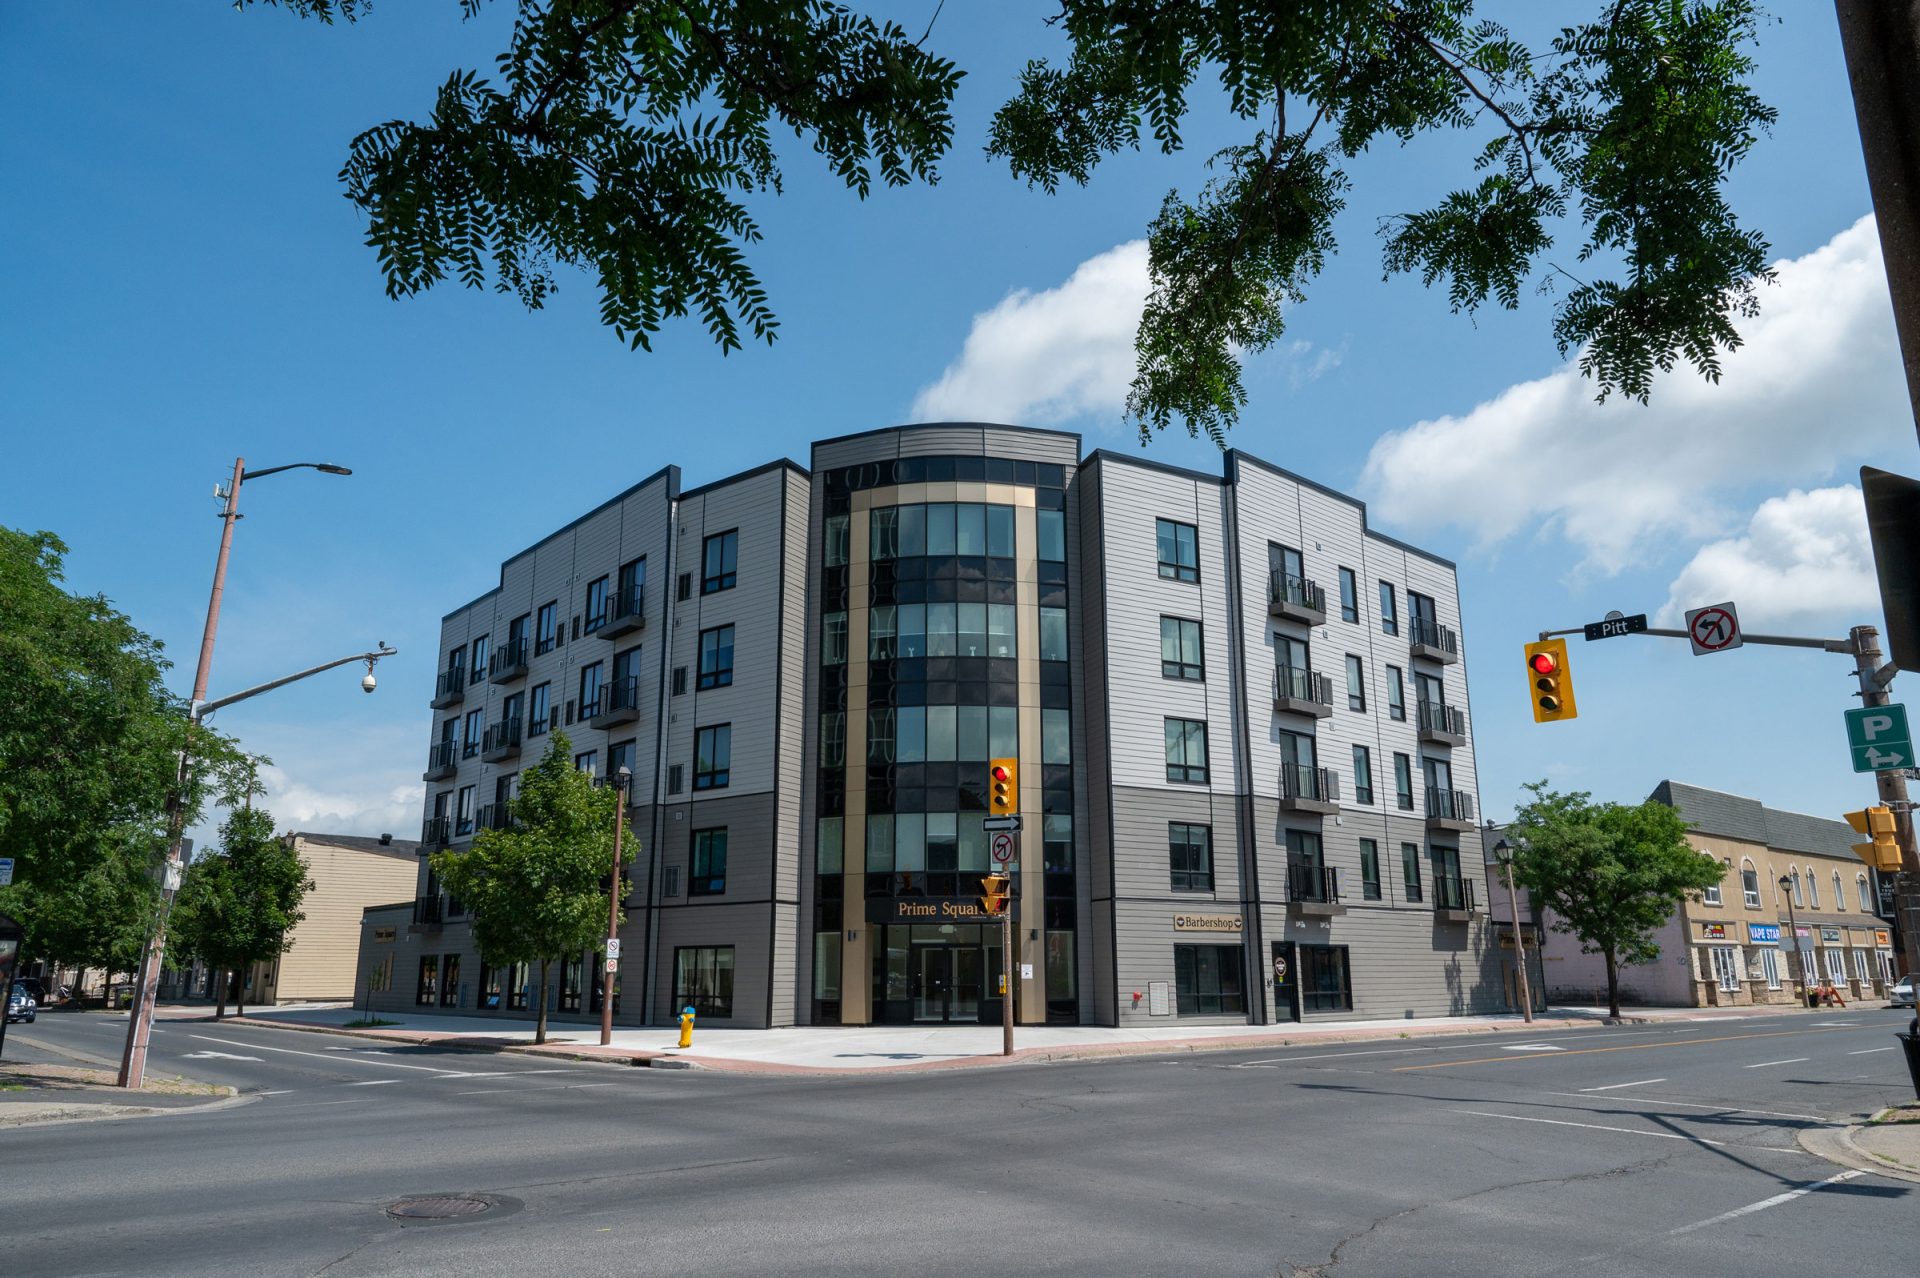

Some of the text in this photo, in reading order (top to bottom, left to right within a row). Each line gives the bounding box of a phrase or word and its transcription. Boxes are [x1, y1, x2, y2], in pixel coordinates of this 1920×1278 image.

[1602, 621, 1629, 636] Pitt
[1862, 715, 1893, 740] P
[898, 901, 989, 919] Prime Squar
[1185, 916, 1234, 930] Barbershop
[1750, 927, 1780, 940] VAPE STAR
